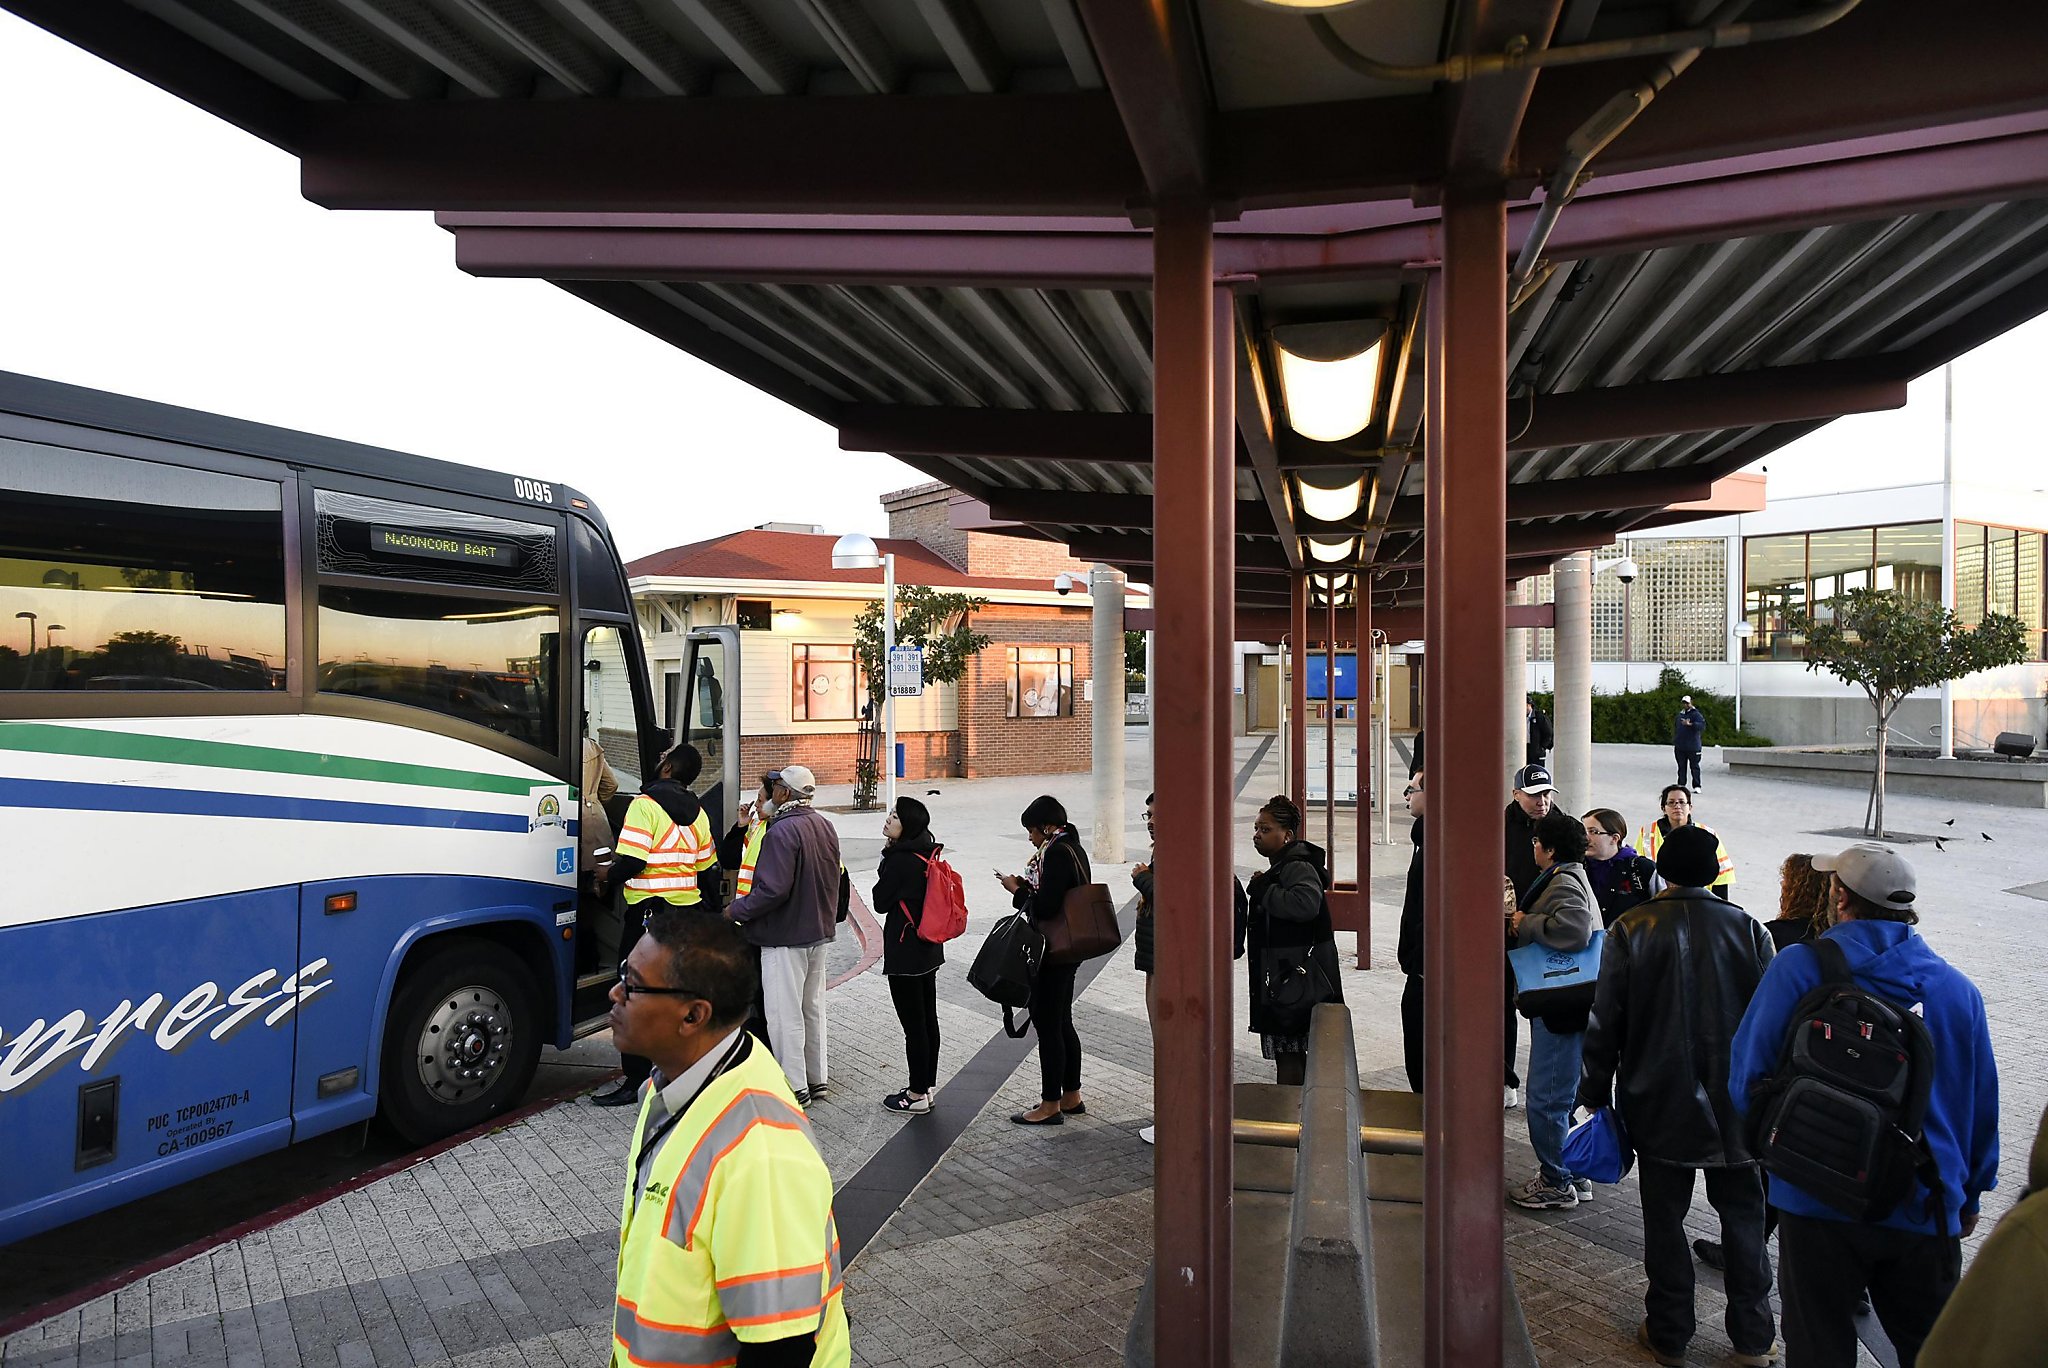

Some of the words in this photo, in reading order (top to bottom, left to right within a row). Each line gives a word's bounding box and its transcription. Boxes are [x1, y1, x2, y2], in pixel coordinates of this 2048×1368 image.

[513, 477, 553, 503] 0095
[385, 531, 459, 553] N.CONCORD
[464, 543, 497, 558] BART
[0, 957, 333, 1092] press
[148, 1113, 170, 1132] PUC
[176, 1089, 250, 1123] TCP0024770-A
[158, 1120, 234, 1156] CA-100967
[166, 1120, 203, 1138] Operated
[205, 1117, 216, 1126] By
